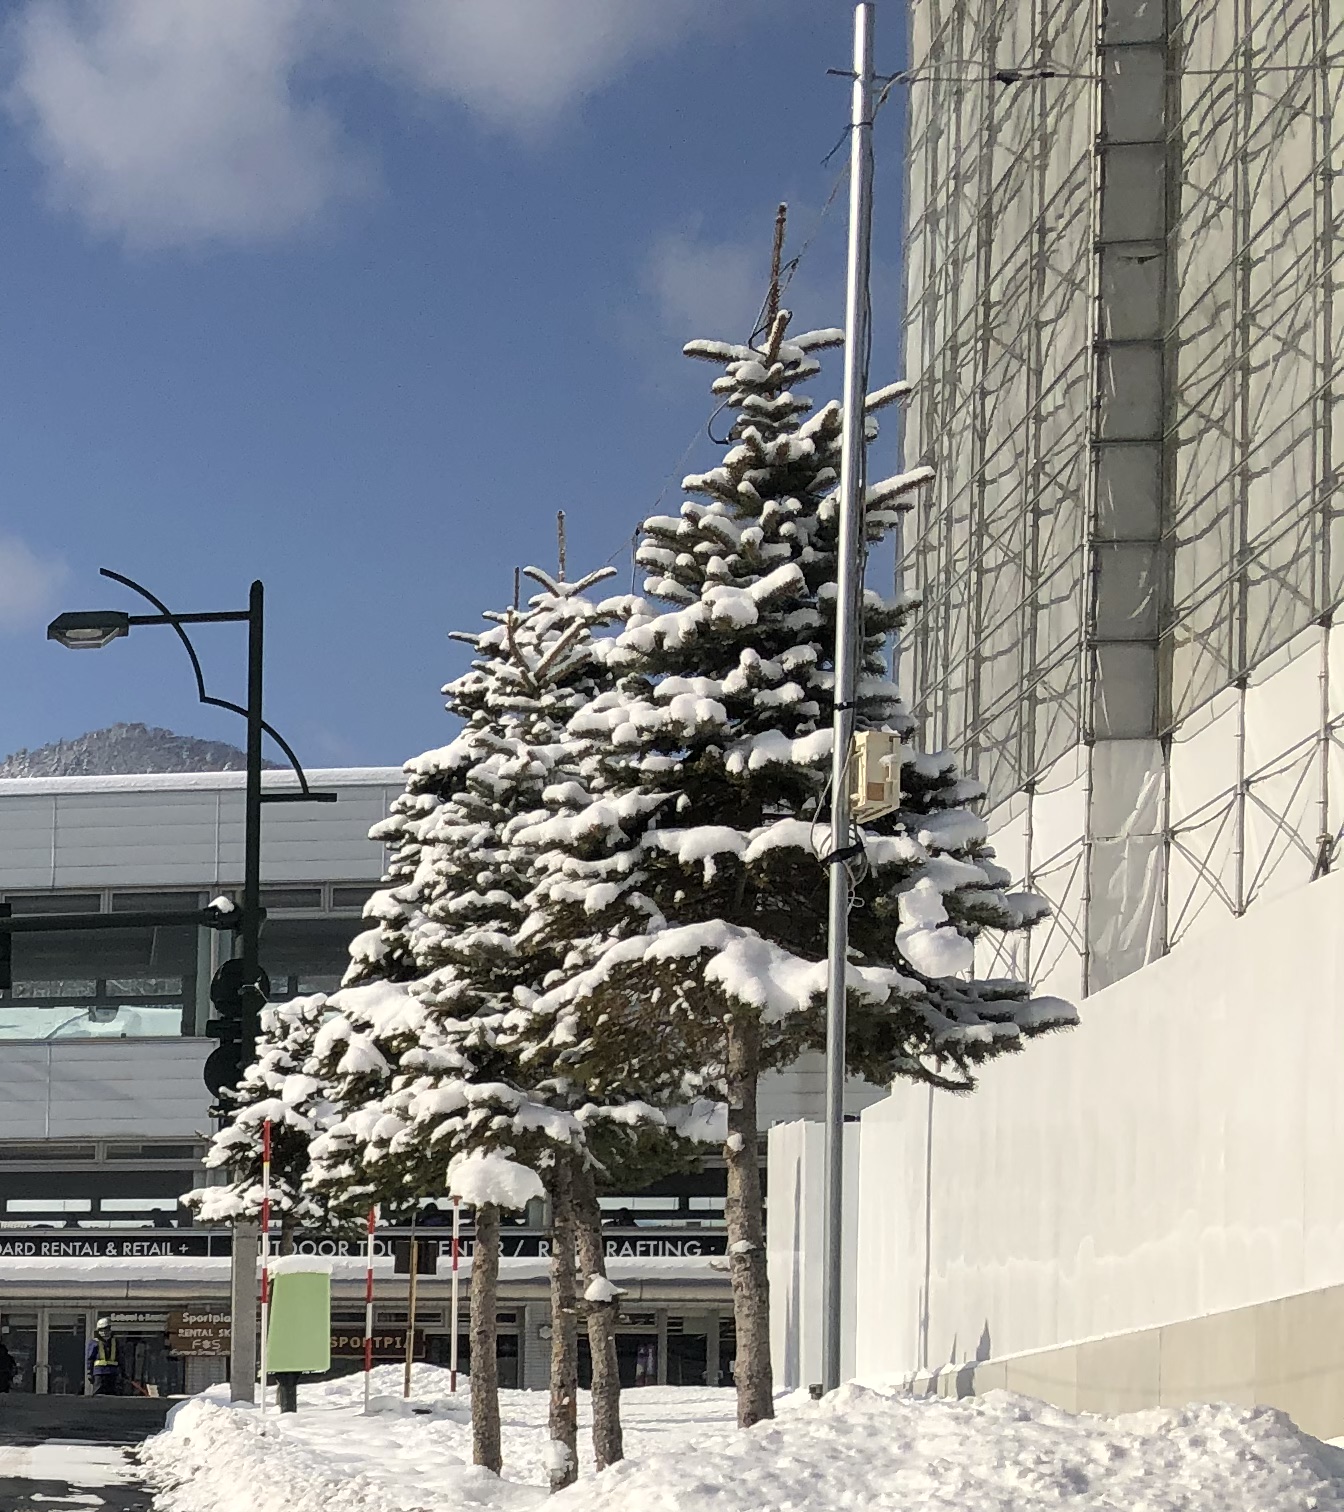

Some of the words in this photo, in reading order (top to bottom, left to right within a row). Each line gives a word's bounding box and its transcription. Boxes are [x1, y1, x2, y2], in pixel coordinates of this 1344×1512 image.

[41, 1242, 100, 1256] RENTAL
[105, 1242, 118, 1256] &
[122, 1242, 174, 1256] RETAIL
[258, 1240, 349, 1257] UTOOR
[606, 1240, 702, 1257] RAFTING
[218, 1328, 231, 1337] SK
